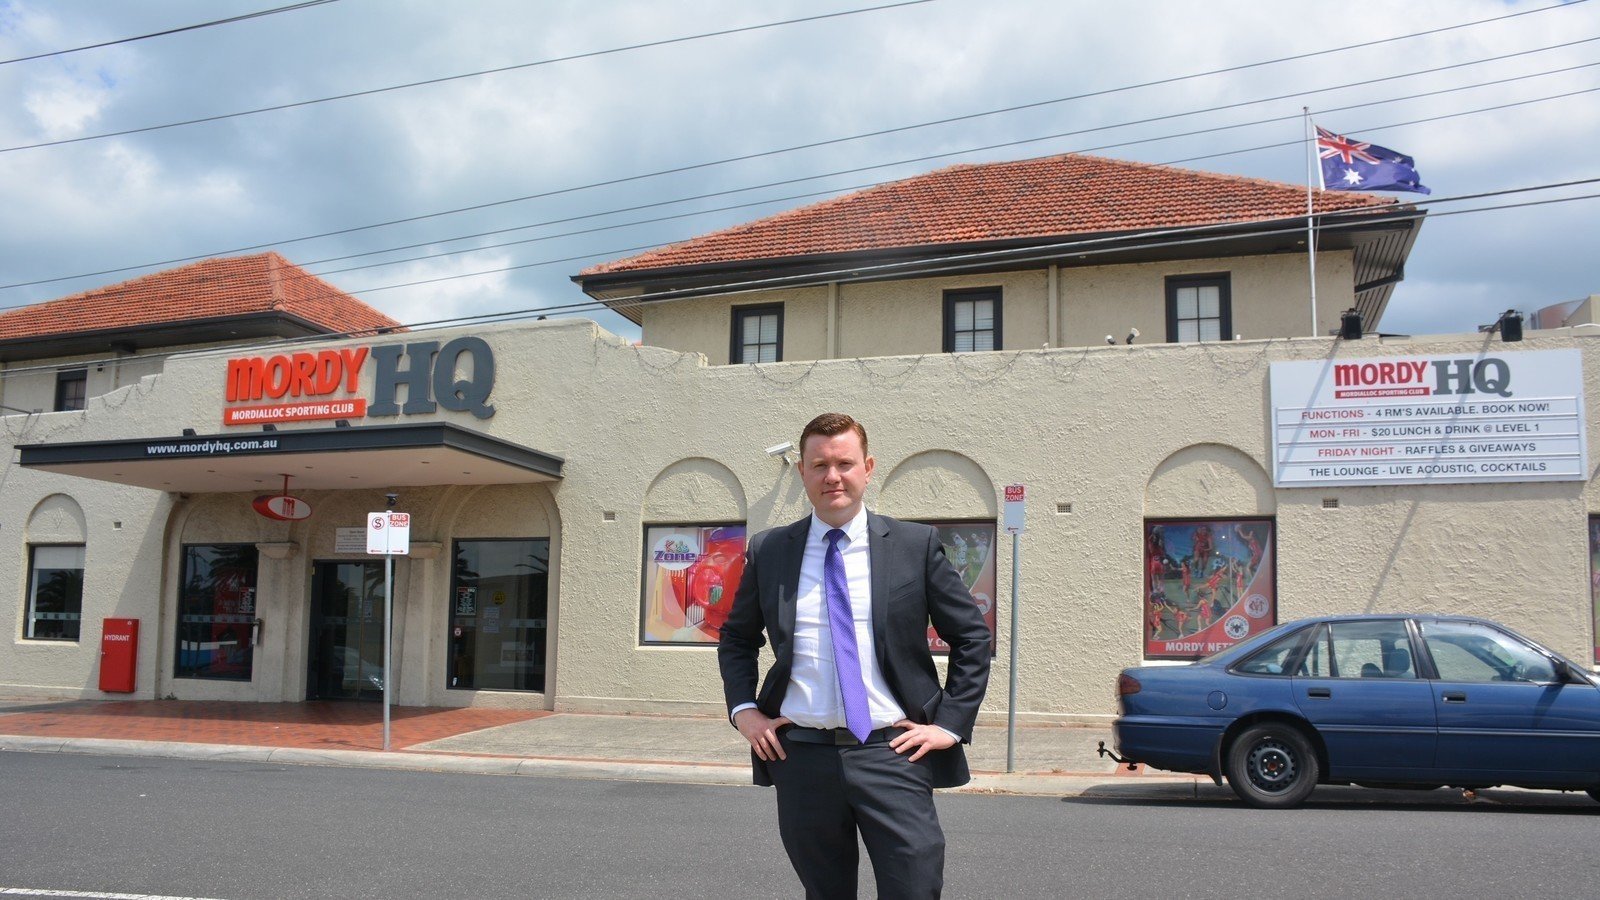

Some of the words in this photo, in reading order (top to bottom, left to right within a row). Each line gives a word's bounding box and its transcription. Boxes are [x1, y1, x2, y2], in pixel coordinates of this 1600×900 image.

[367, 336, 496, 419] HQ
[1431, 358, 1513, 398] HQ
[1340, 390, 1378, 398] MORDIALLOC
[231, 406, 284, 420] MORDIALLOC
[285, 404, 329, 417] SPORTING
[331, 402, 354, 414] CLUB
[1301, 409, 1364, 420] FUNCTIONS
[1375, 409, 1382, 417] 4
[1384, 408, 1413, 417] RM'S
[1415, 406, 1479, 416] AVAILABLE.
[1482, 404, 1516, 414] BOOK
[1518, 403, 1550, 412] NOW!
[1371, 427, 1391, 437] $20
[1393, 426, 1431, 436] LUNCH
[1434, 426, 1441, 434] &
[1445, 425, 1480, 434] DRINK
[1483, 424, 1493, 433] @
[1496, 424, 1531, 433] LEVEL
[1535, 423, 1540, 431] 1
[147, 439, 277, 453] www.mordyhq.com.au
[1318, 448, 1358, 457] FRIDAY
[1360, 446, 1395, 456] NIGHT
[1405, 445, 1456, 455] RAFFLES
[1458, 444, 1465, 453] &
[1468, 443, 1536, 453] GIVEAWAYS
[1309, 468, 1331, 477] THE
[1333, 466, 1379, 476] LOUNGE
[1389, 465, 1413, 475] LIVE
[1416, 464, 1477, 474] ACOUSTIC,
[1480, 462, 1547, 472] COCKTAILS
[654, 550, 696, 562] Zone
[1165, 642, 1205, 651] MORDY
